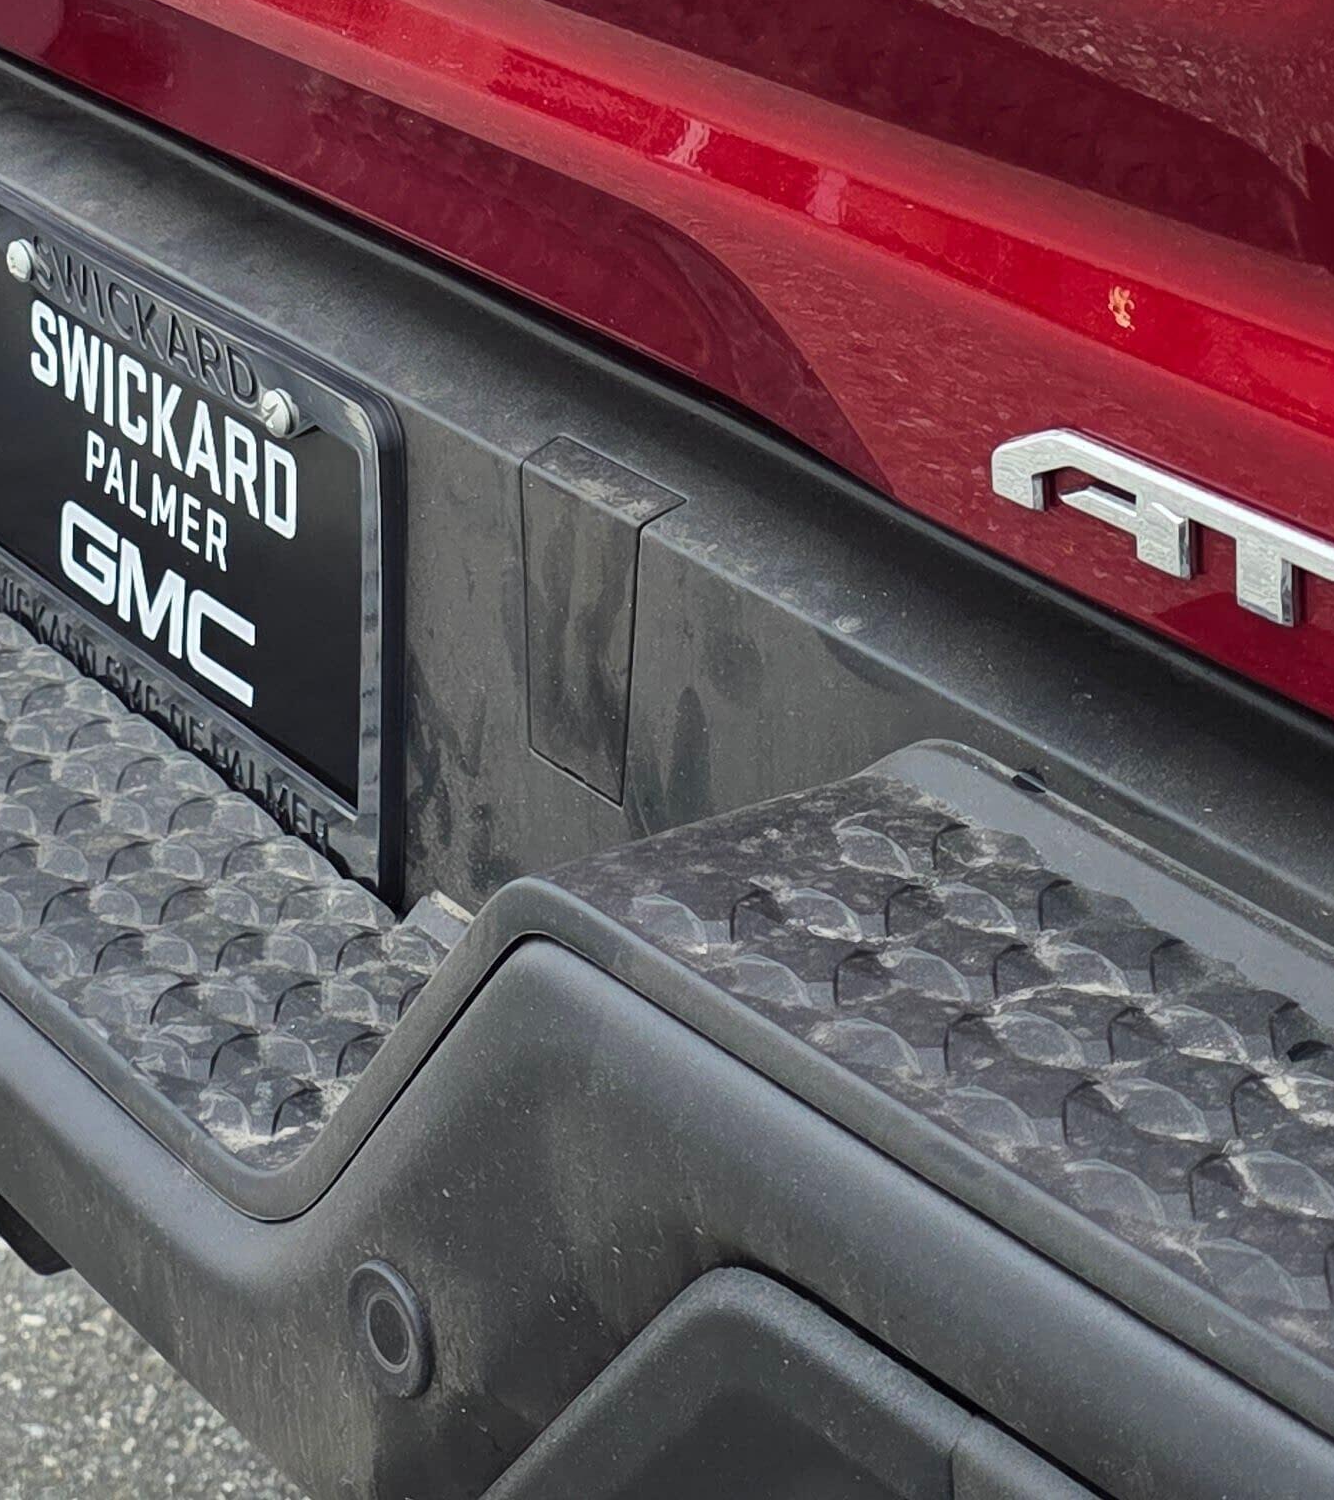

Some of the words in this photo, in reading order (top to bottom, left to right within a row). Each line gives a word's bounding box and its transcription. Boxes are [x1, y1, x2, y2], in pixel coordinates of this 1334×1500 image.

[31, 235, 261, 410] SWICKARD
[30, 300, 298, 540] SWICKARD
[85, 430, 228, 572] PALMER
[60, 500, 256, 708] GMC
